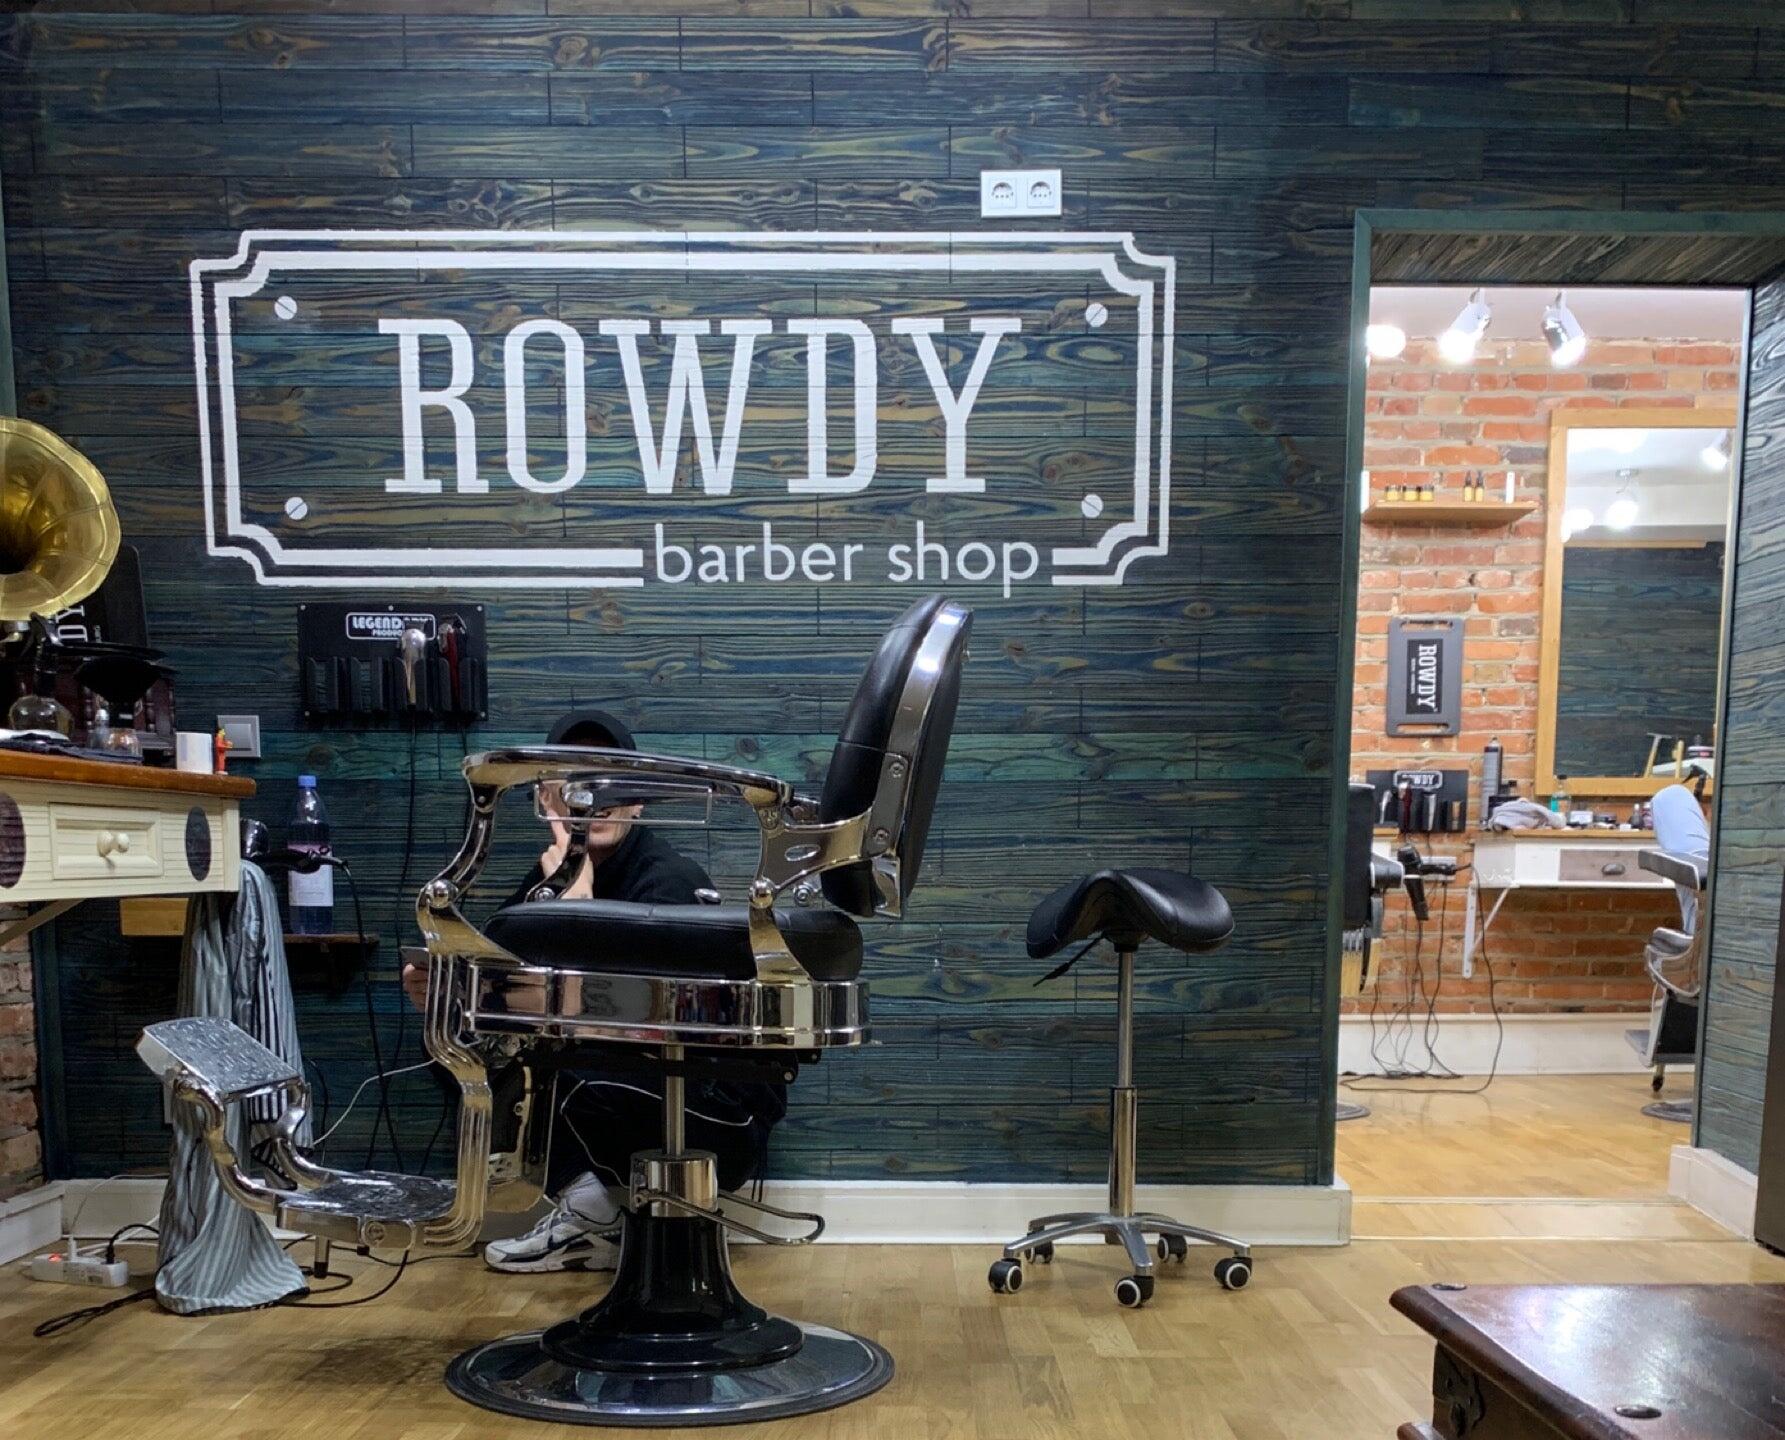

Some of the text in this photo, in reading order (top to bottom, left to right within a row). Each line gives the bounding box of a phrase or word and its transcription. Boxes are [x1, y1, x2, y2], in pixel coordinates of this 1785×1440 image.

[378, 317, 1023, 495] ROWDY
[654, 519, 1040, 600] barber shop
[1416, 643, 1438, 709] ROWDY
